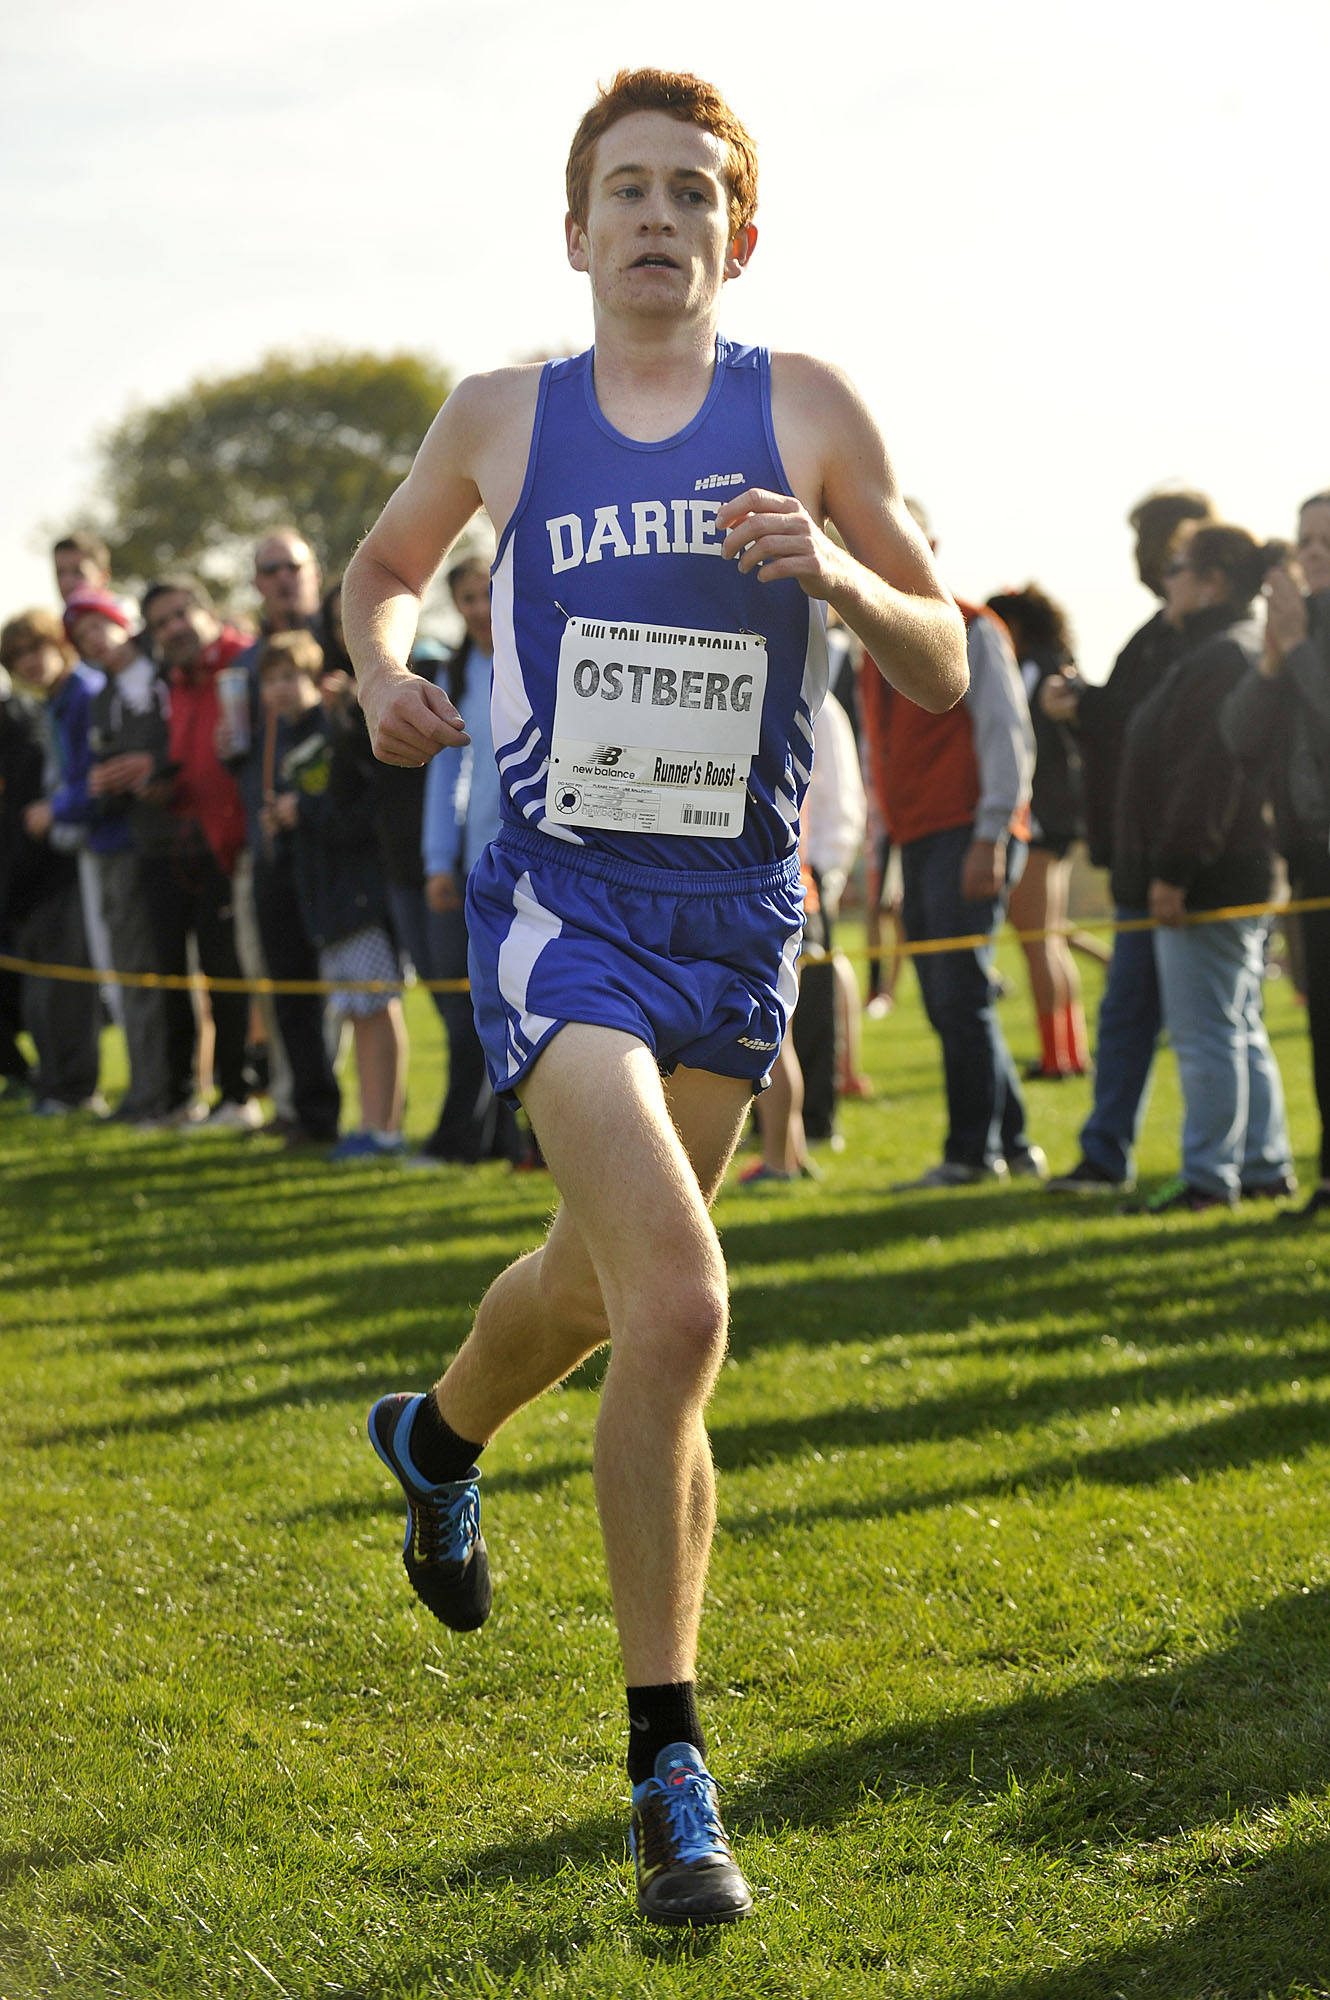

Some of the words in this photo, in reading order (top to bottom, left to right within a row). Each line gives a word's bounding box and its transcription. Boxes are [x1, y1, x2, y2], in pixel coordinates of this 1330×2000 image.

[694, 473, 744, 491] HIND
[573, 659, 753, 712] OSTBERG
[572, 765, 594, 775] new
[594, 766, 636, 779] balance
[653, 756, 702, 785] Runner's
[704, 761, 736, 787] Roost
